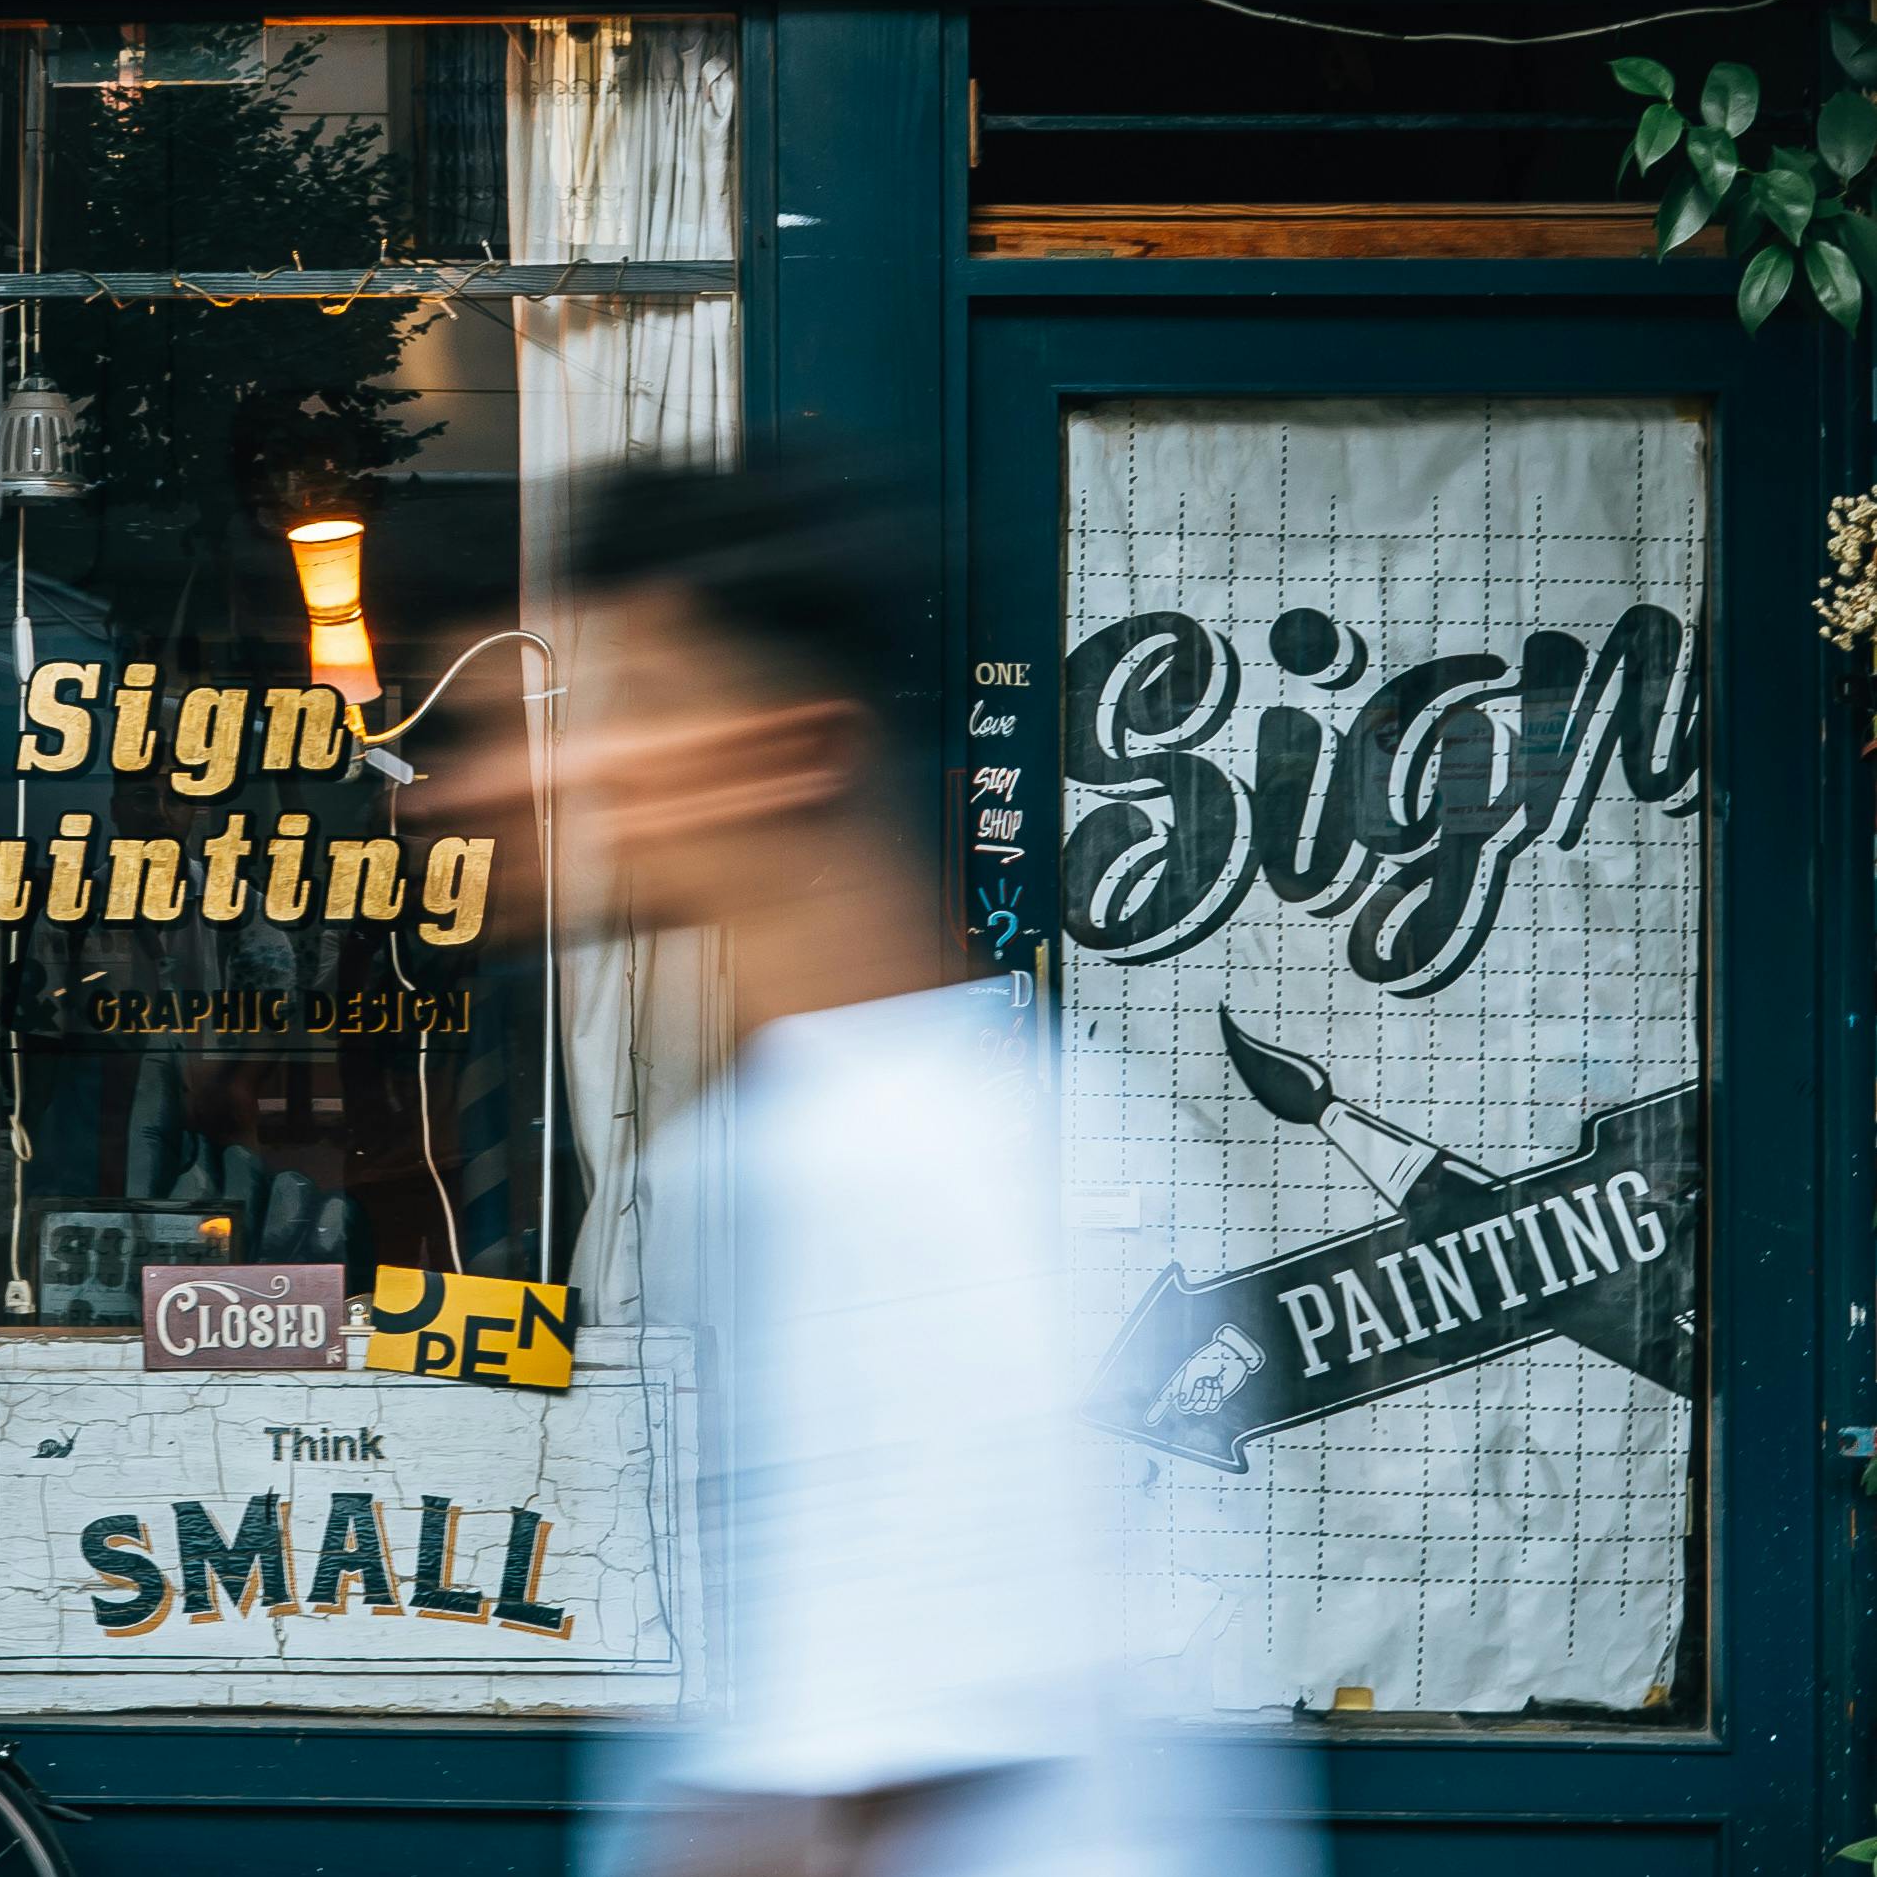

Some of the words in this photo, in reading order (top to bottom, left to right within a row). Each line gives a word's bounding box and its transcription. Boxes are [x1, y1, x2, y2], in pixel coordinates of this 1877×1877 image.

[975, 663, 1031, 686] ONE
[17, 660, 348, 798] Sign
[978, 808, 1023, 841] SHOP
[1063, 603, 1701, 998] Sign
[89, 989, 289, 1035] GRAPHIC
[304, 989, 471, 1035] DESIGN
[1278, 1169, 1668, 1379] PAINTING
[263, 1425, 385, 1463] Think
[80, 1488, 575, 1641] SMALL
